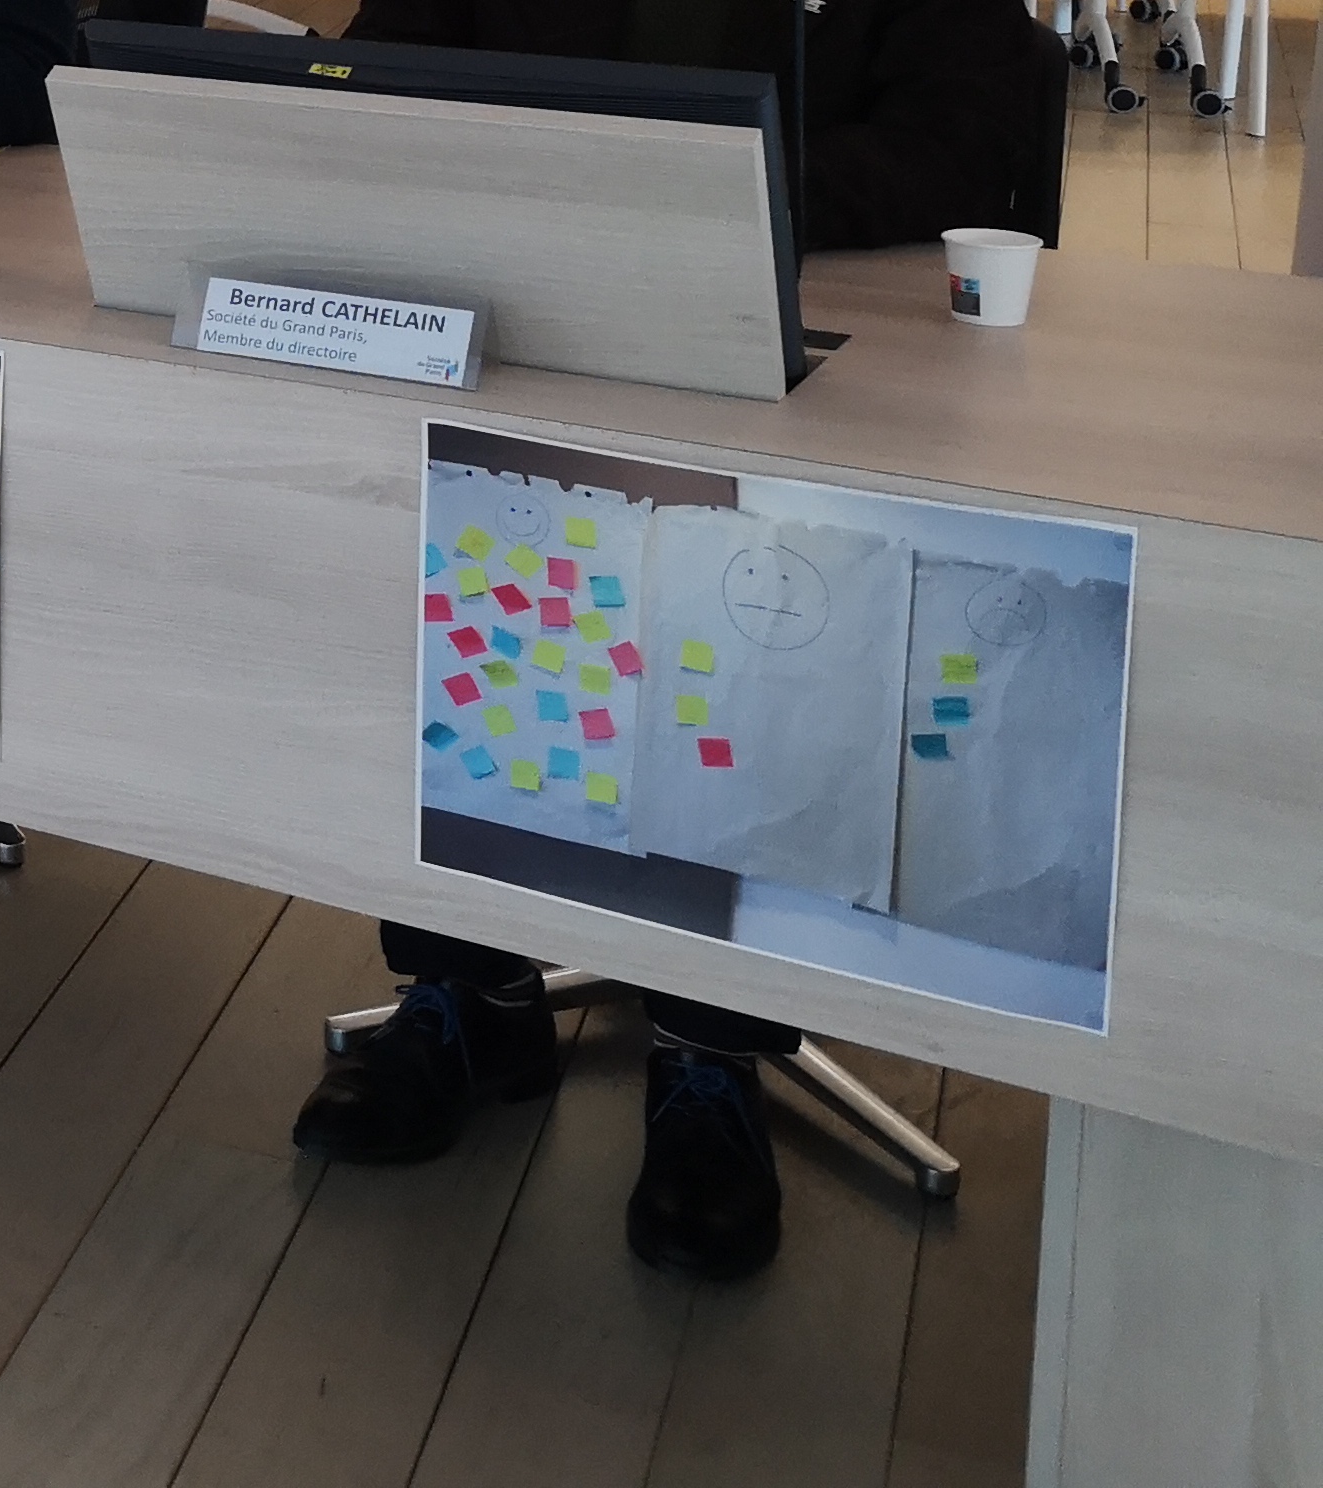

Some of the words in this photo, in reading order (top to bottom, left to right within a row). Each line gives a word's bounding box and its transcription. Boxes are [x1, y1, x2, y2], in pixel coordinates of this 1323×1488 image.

[206, 308, 256, 327] Société
[259, 314, 278, 331] du
[282, 318, 326, 338] Grand
[329, 324, 368, 345] Paris,
[229, 288, 315, 315] Bernard
[321, 300, 446, 333] CATHELAIN
[203, 328, 263, 350] Membre
[266, 336, 285, 352] du
[287, 340, 358, 363] directoire
